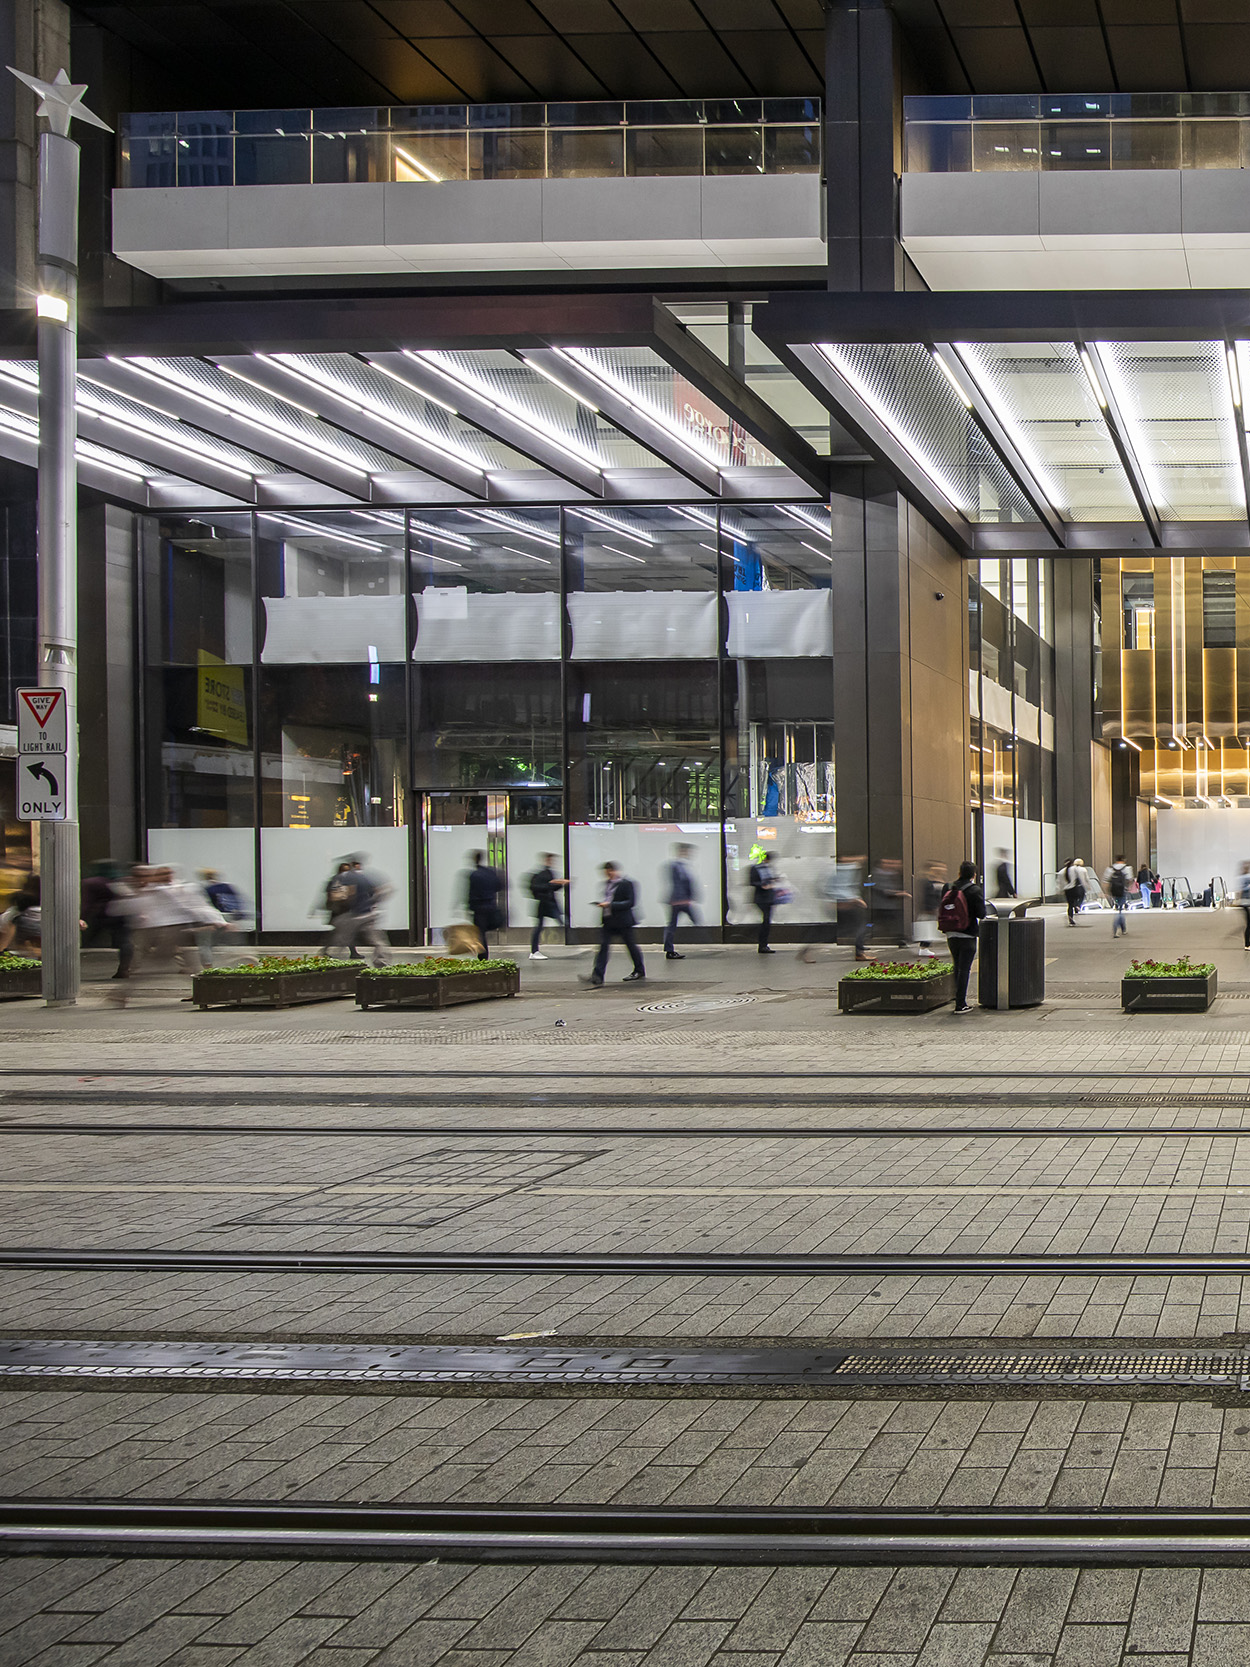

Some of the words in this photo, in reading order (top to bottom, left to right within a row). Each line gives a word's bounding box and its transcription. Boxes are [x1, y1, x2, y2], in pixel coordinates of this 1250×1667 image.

[38, 731, 48, 741] TO
[23, 742, 43, 752] LIGHT
[46, 742, 63, 752] RAIL
[22, 801, 62, 814] ONLY
